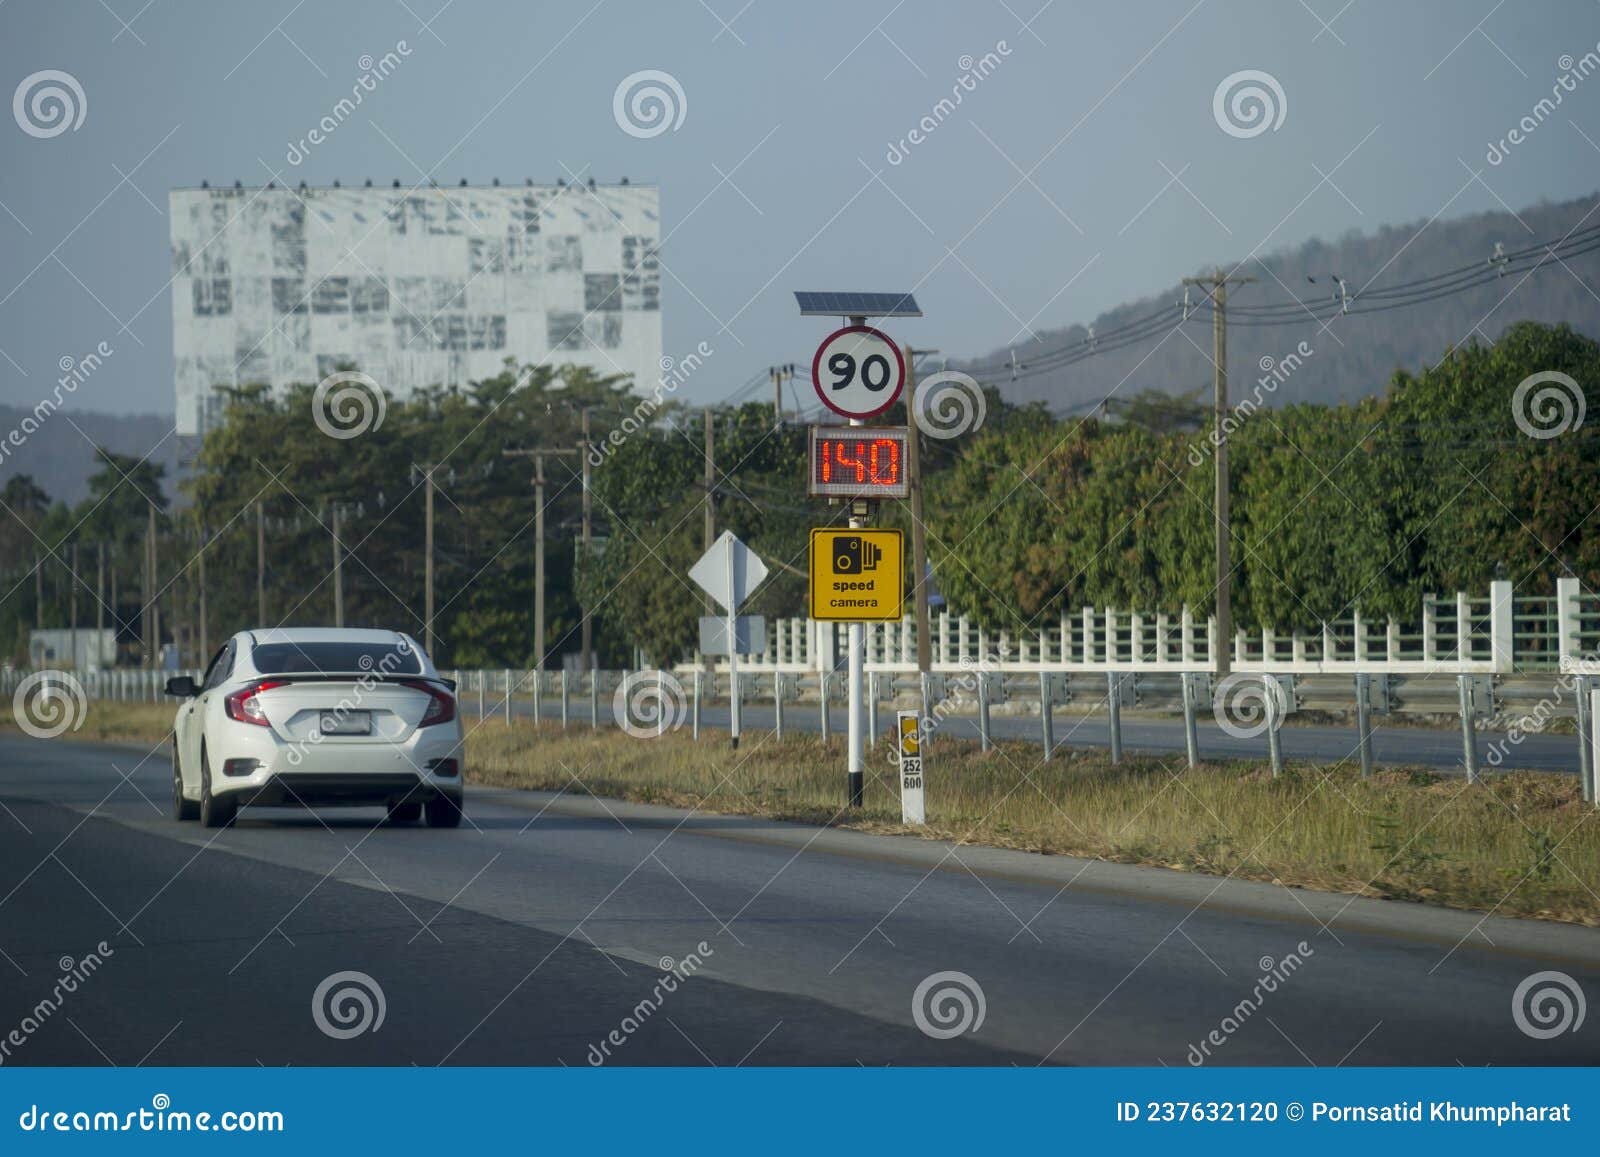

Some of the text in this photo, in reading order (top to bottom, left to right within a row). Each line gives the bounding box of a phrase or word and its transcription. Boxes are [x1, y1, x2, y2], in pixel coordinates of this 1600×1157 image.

[828, 352, 891, 392] 90
[823, 438, 898, 485] 140
[832, 580, 875, 593] speed
[830, 599, 878, 608] camera
[903, 759, 921, 772] 252
[903, 777, 922, 790] 600
